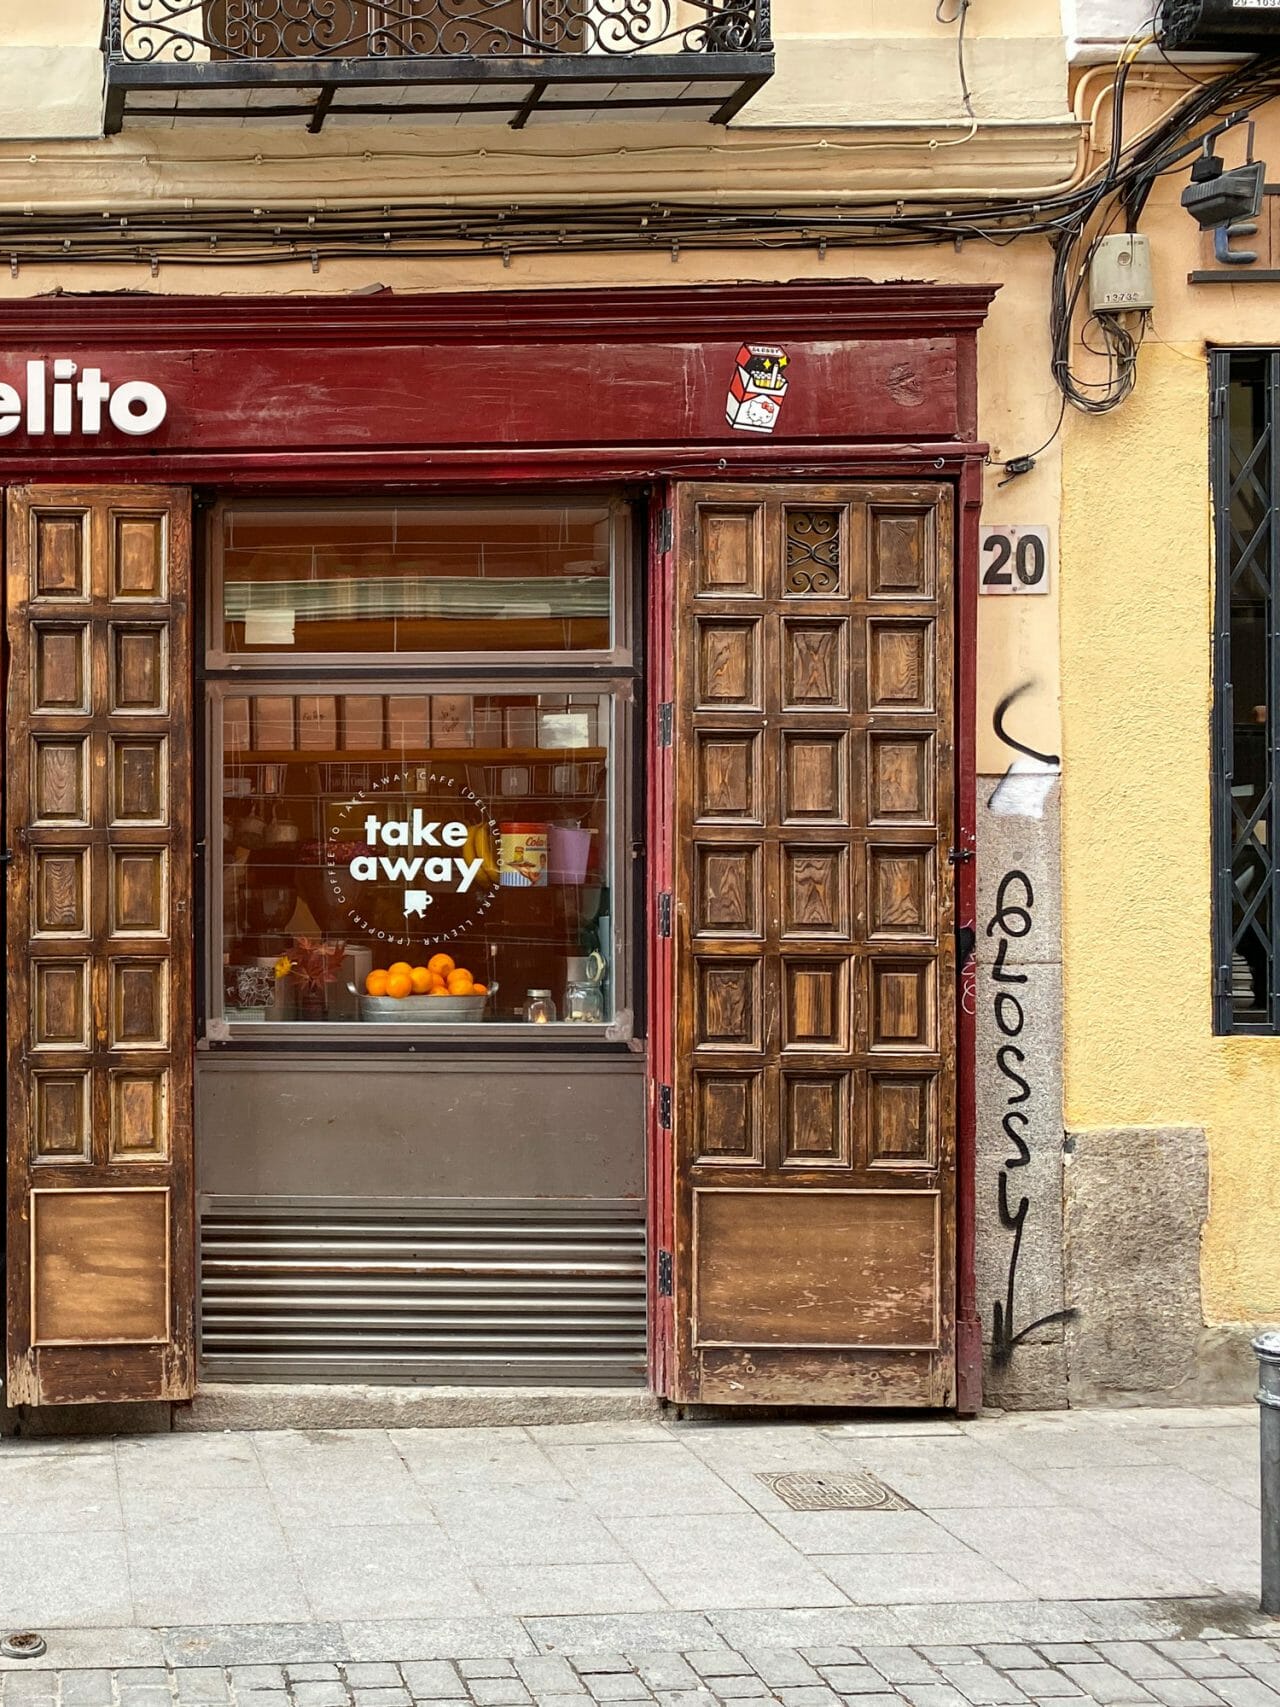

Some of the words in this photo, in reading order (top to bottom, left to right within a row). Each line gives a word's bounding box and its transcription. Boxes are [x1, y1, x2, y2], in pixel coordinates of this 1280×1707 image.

[982, 534, 1045, 586] 20
[372, 773, 410, 790] AWAY
[419, 771, 455, 787] CAFÉ
[339, 790, 366, 819] TAKE
[461, 786, 486, 813] (DEL
[329, 826, 340, 843] TO
[364, 808, 469, 847] take
[327, 852, 346, 904] COFFEE
[349, 855, 484, 893] away
[477, 883, 500, 915] PARA
[347, 909, 411, 947] (PROPER)
[423, 919, 473, 946] LLEVAR
